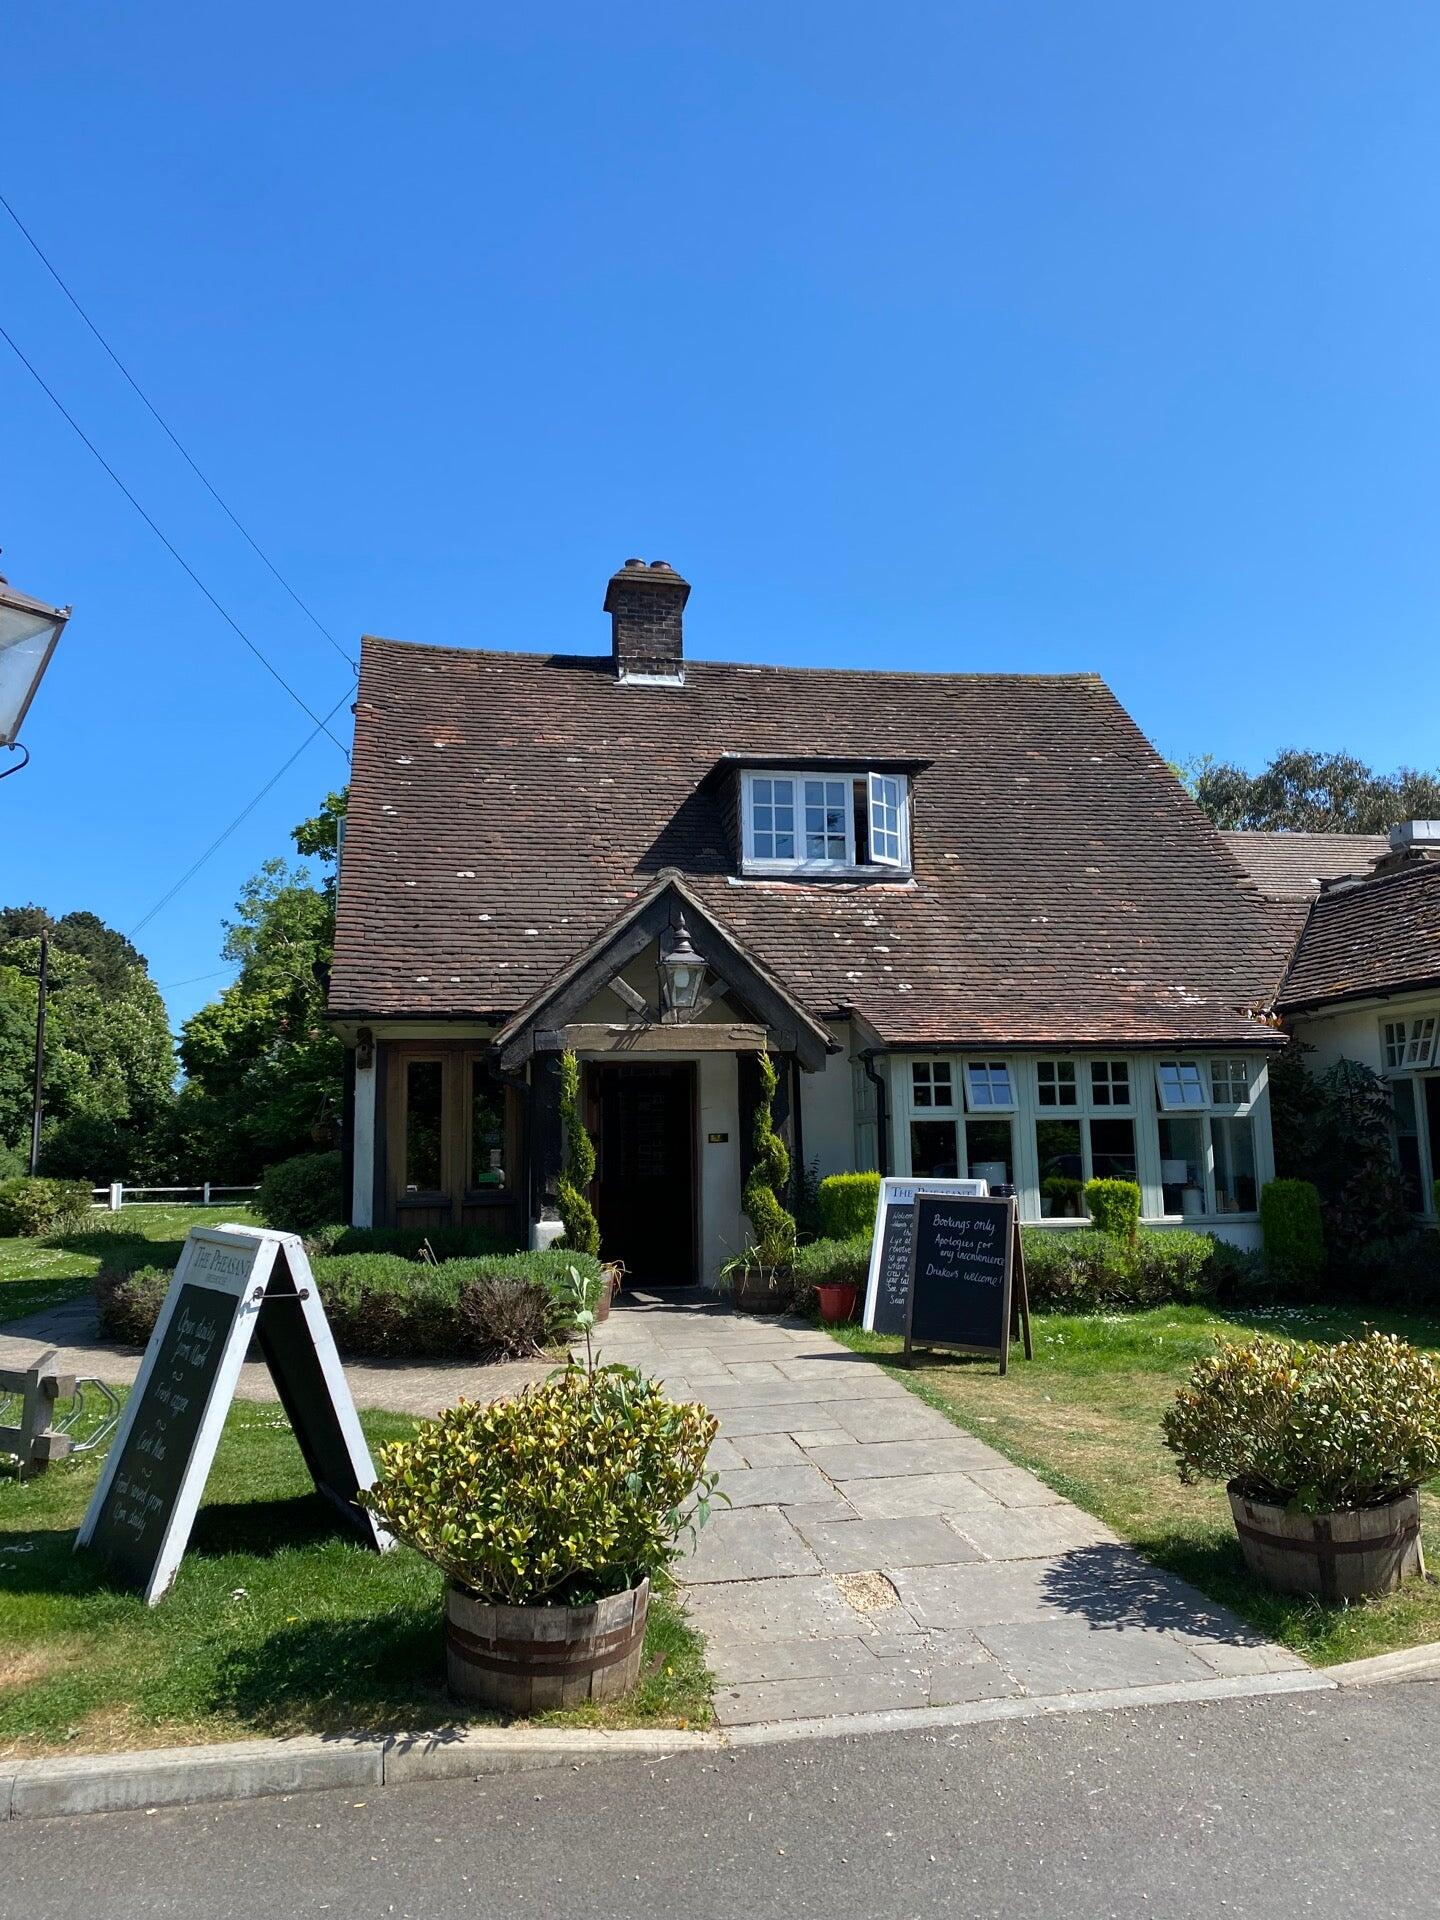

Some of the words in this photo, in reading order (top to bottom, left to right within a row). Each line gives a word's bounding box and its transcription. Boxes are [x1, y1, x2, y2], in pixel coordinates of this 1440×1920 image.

[932, 1213, 970, 1235] Bookings
[973, 1218, 996, 1237] only
[934, 1233, 974, 1251] Apologies
[976, 1240, 994, 1254] for
[194, 1246, 212, 1269] THE
[210, 1249, 252, 1278] PHEASANT
[940, 1250, 955, 1264] any
[956, 1249, 1006, 1266] inconvenience
[925, 1263, 959, 1279] Drinkers
[964, 1271, 1003, 1287] welcome!
